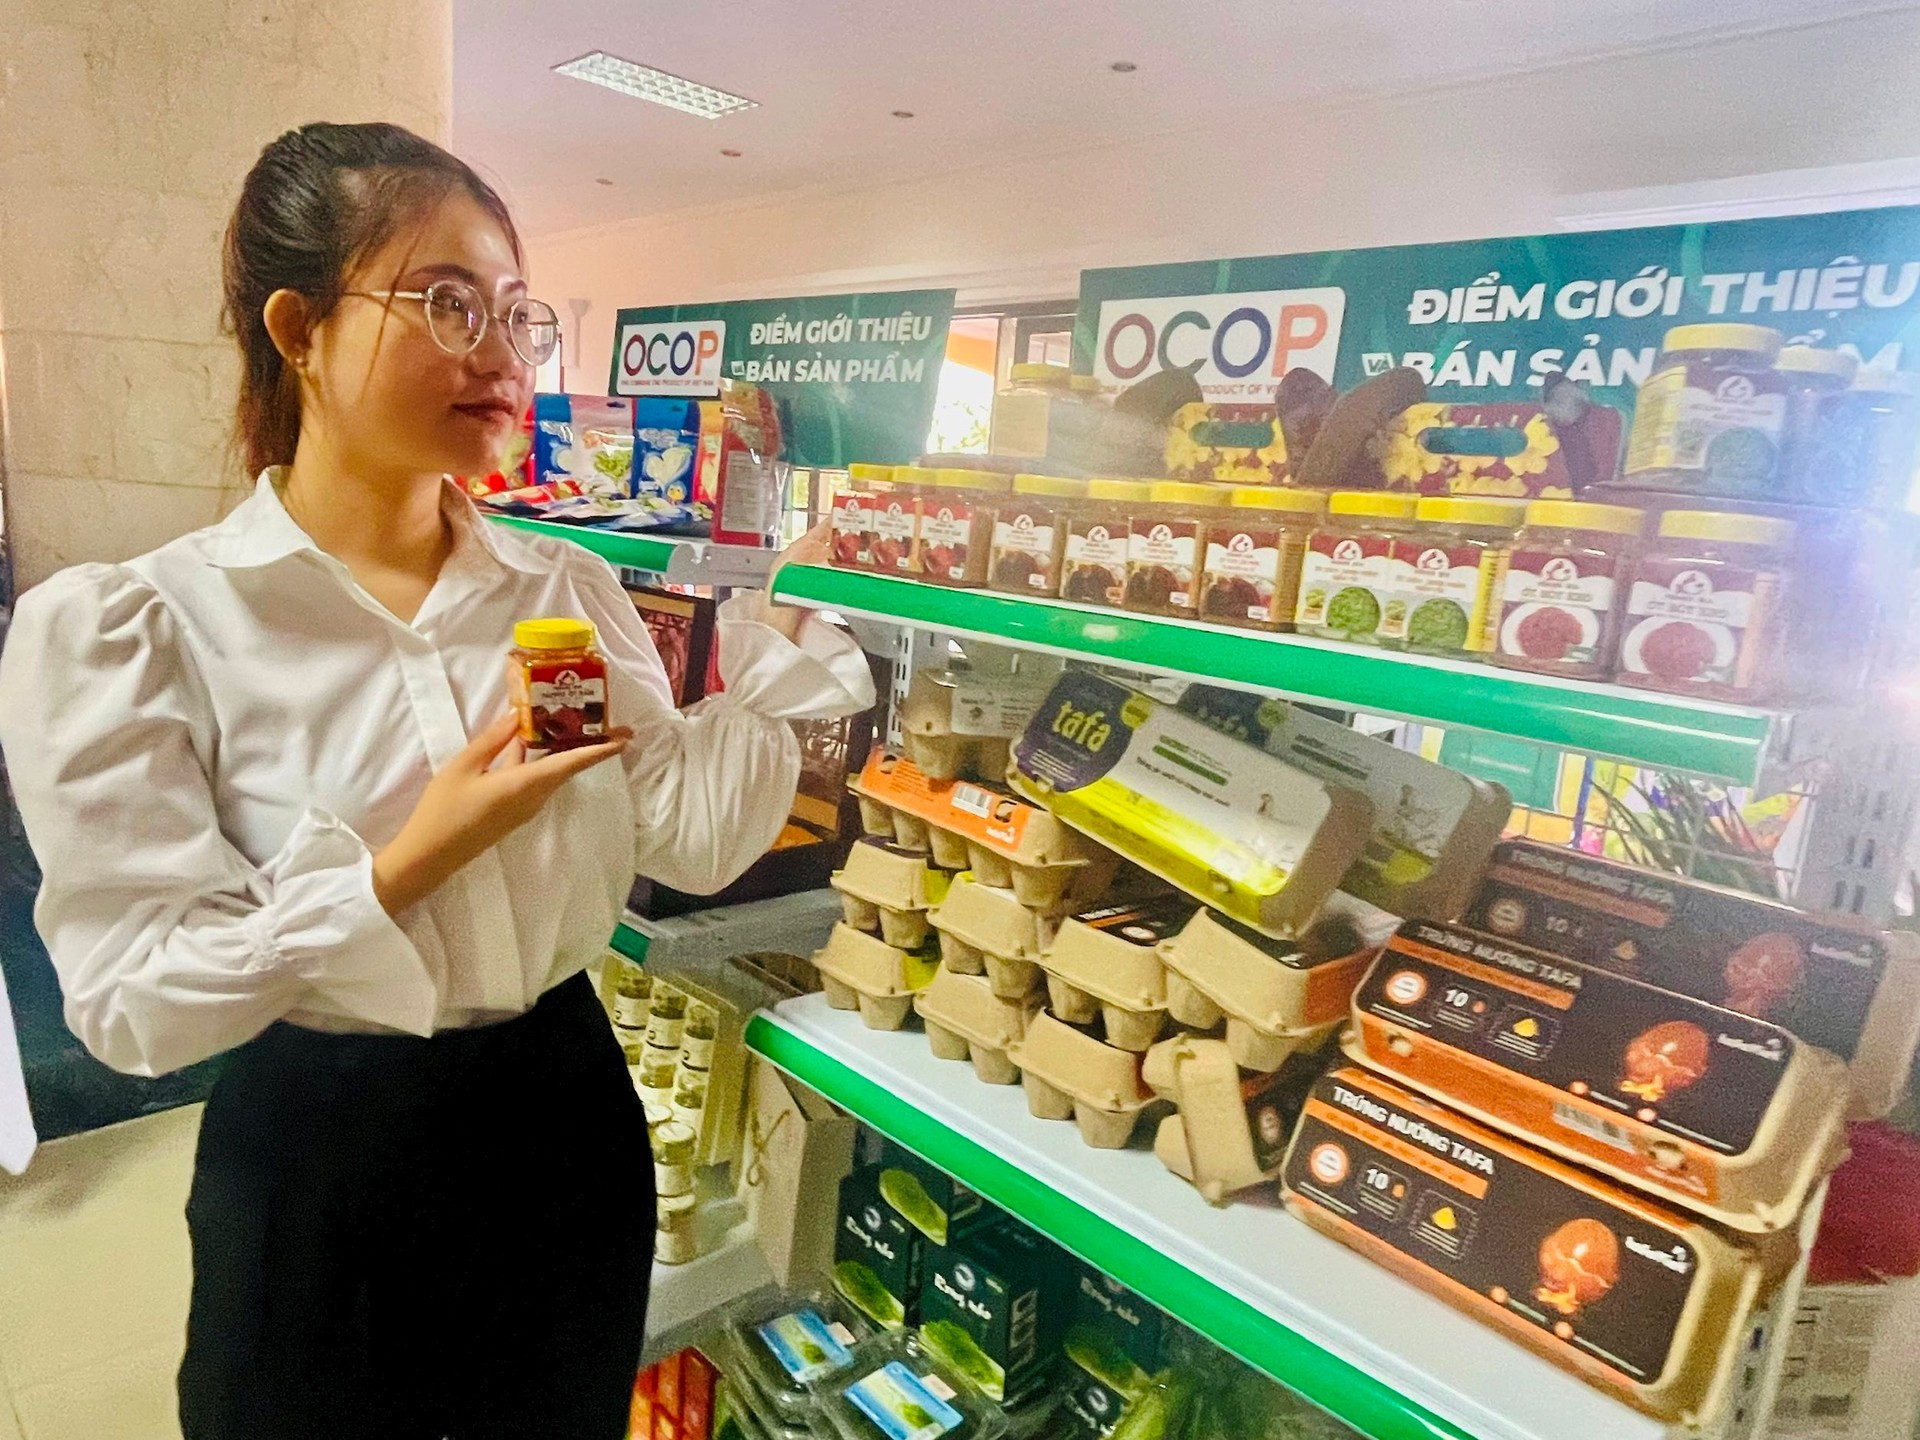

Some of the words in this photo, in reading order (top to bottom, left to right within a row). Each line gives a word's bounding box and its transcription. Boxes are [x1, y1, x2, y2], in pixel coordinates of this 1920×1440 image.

[1408, 271, 1546, 324] ĐIỂM
[1554, 265, 1686, 320] GIỚI
[1701, 254, 1920, 319] THIỆU
[750, 312, 803, 345] ĐIỂM
[805, 312, 853, 345] GIỚI
[858, 310, 933, 346] THIỆU
[1105, 303, 1328, 380] OCOP
[624, 330, 718, 376] OCOP
[746, 354, 791, 383] BÁN
[794, 351, 841, 383] SẢN
[845, 350, 925, 384] PHẨM
[1401, 340, 1517, 388] BÁN
[1526, 333, 1658, 387] SẢN
[1053, 699, 1112, 753] tafa
[1538, 964, 1583, 990] TAFA
[1444, 988, 1469, 1008] 10
[1450, 1141, 1495, 1175] TAFA
[1366, 1168, 1389, 1190] 10
